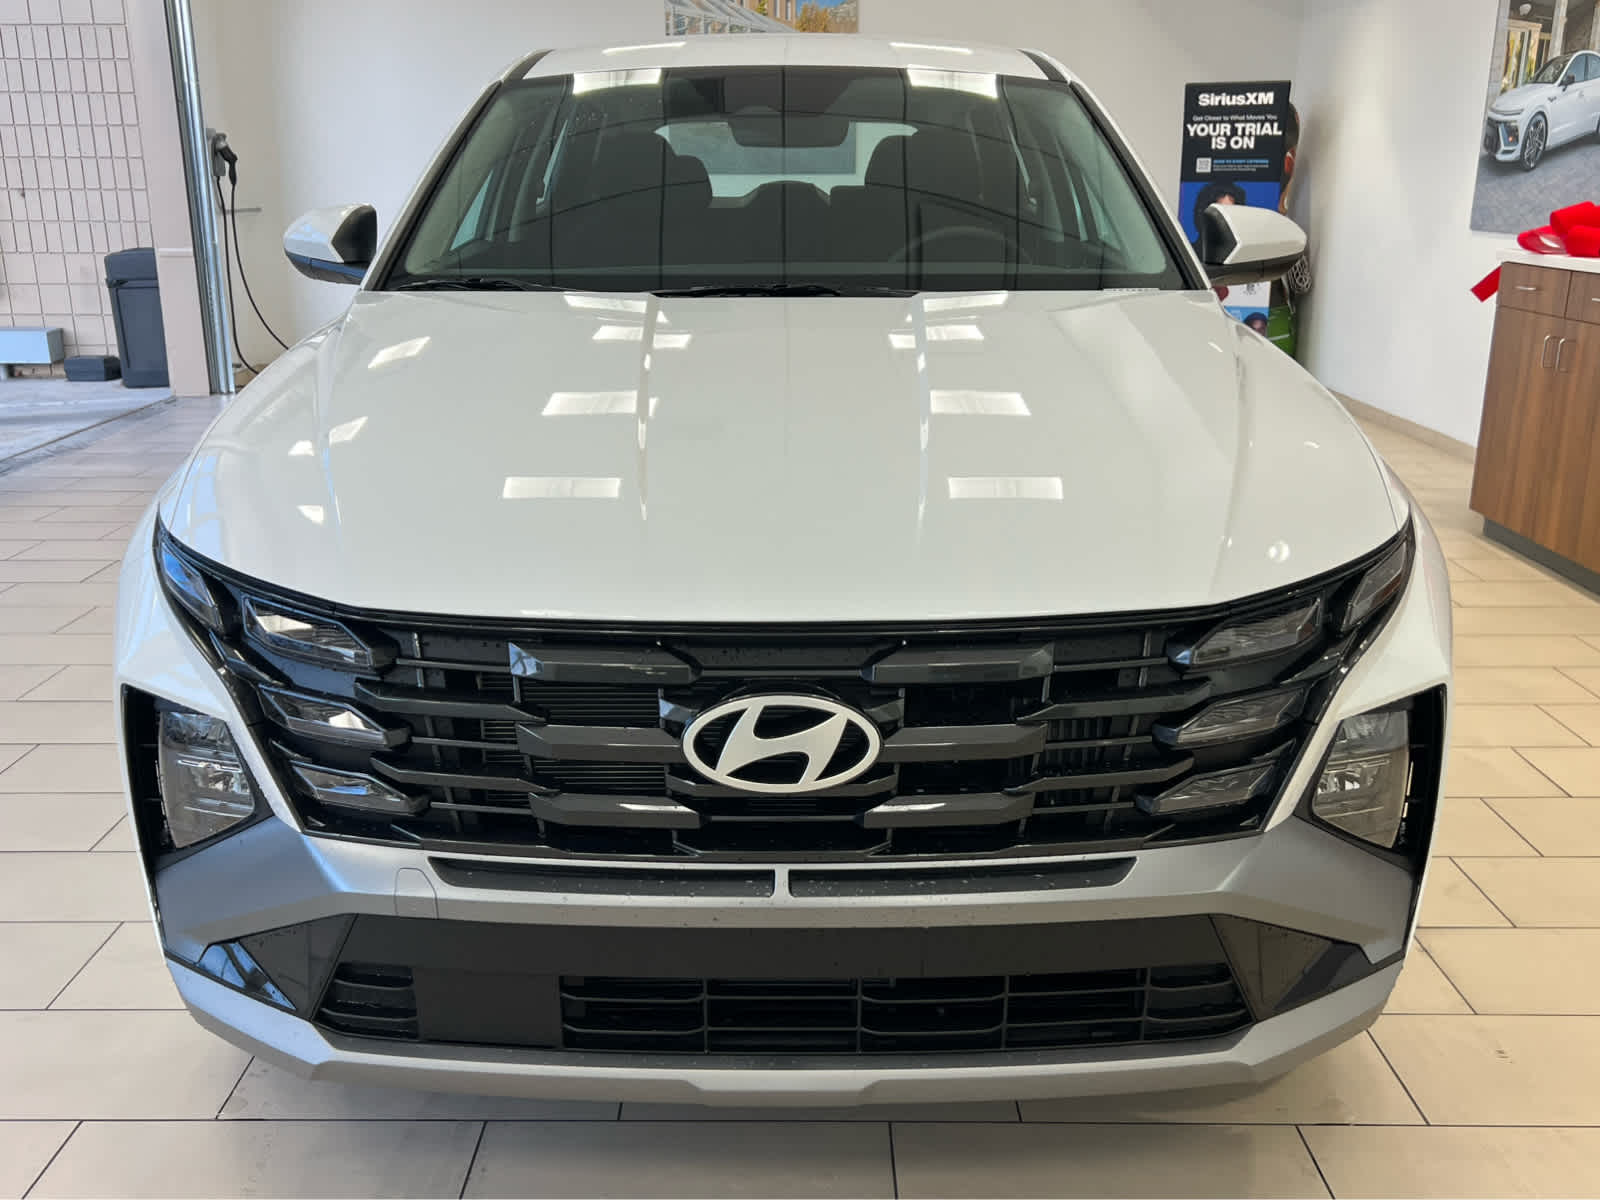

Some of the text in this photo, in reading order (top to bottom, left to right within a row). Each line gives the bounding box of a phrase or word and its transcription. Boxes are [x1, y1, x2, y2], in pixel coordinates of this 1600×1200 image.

[1198, 91, 1274, 107] SiriusXM
[1186, 122, 1282, 137] YOUR TRIAL
[1211, 136, 1255, 150] IS ON
